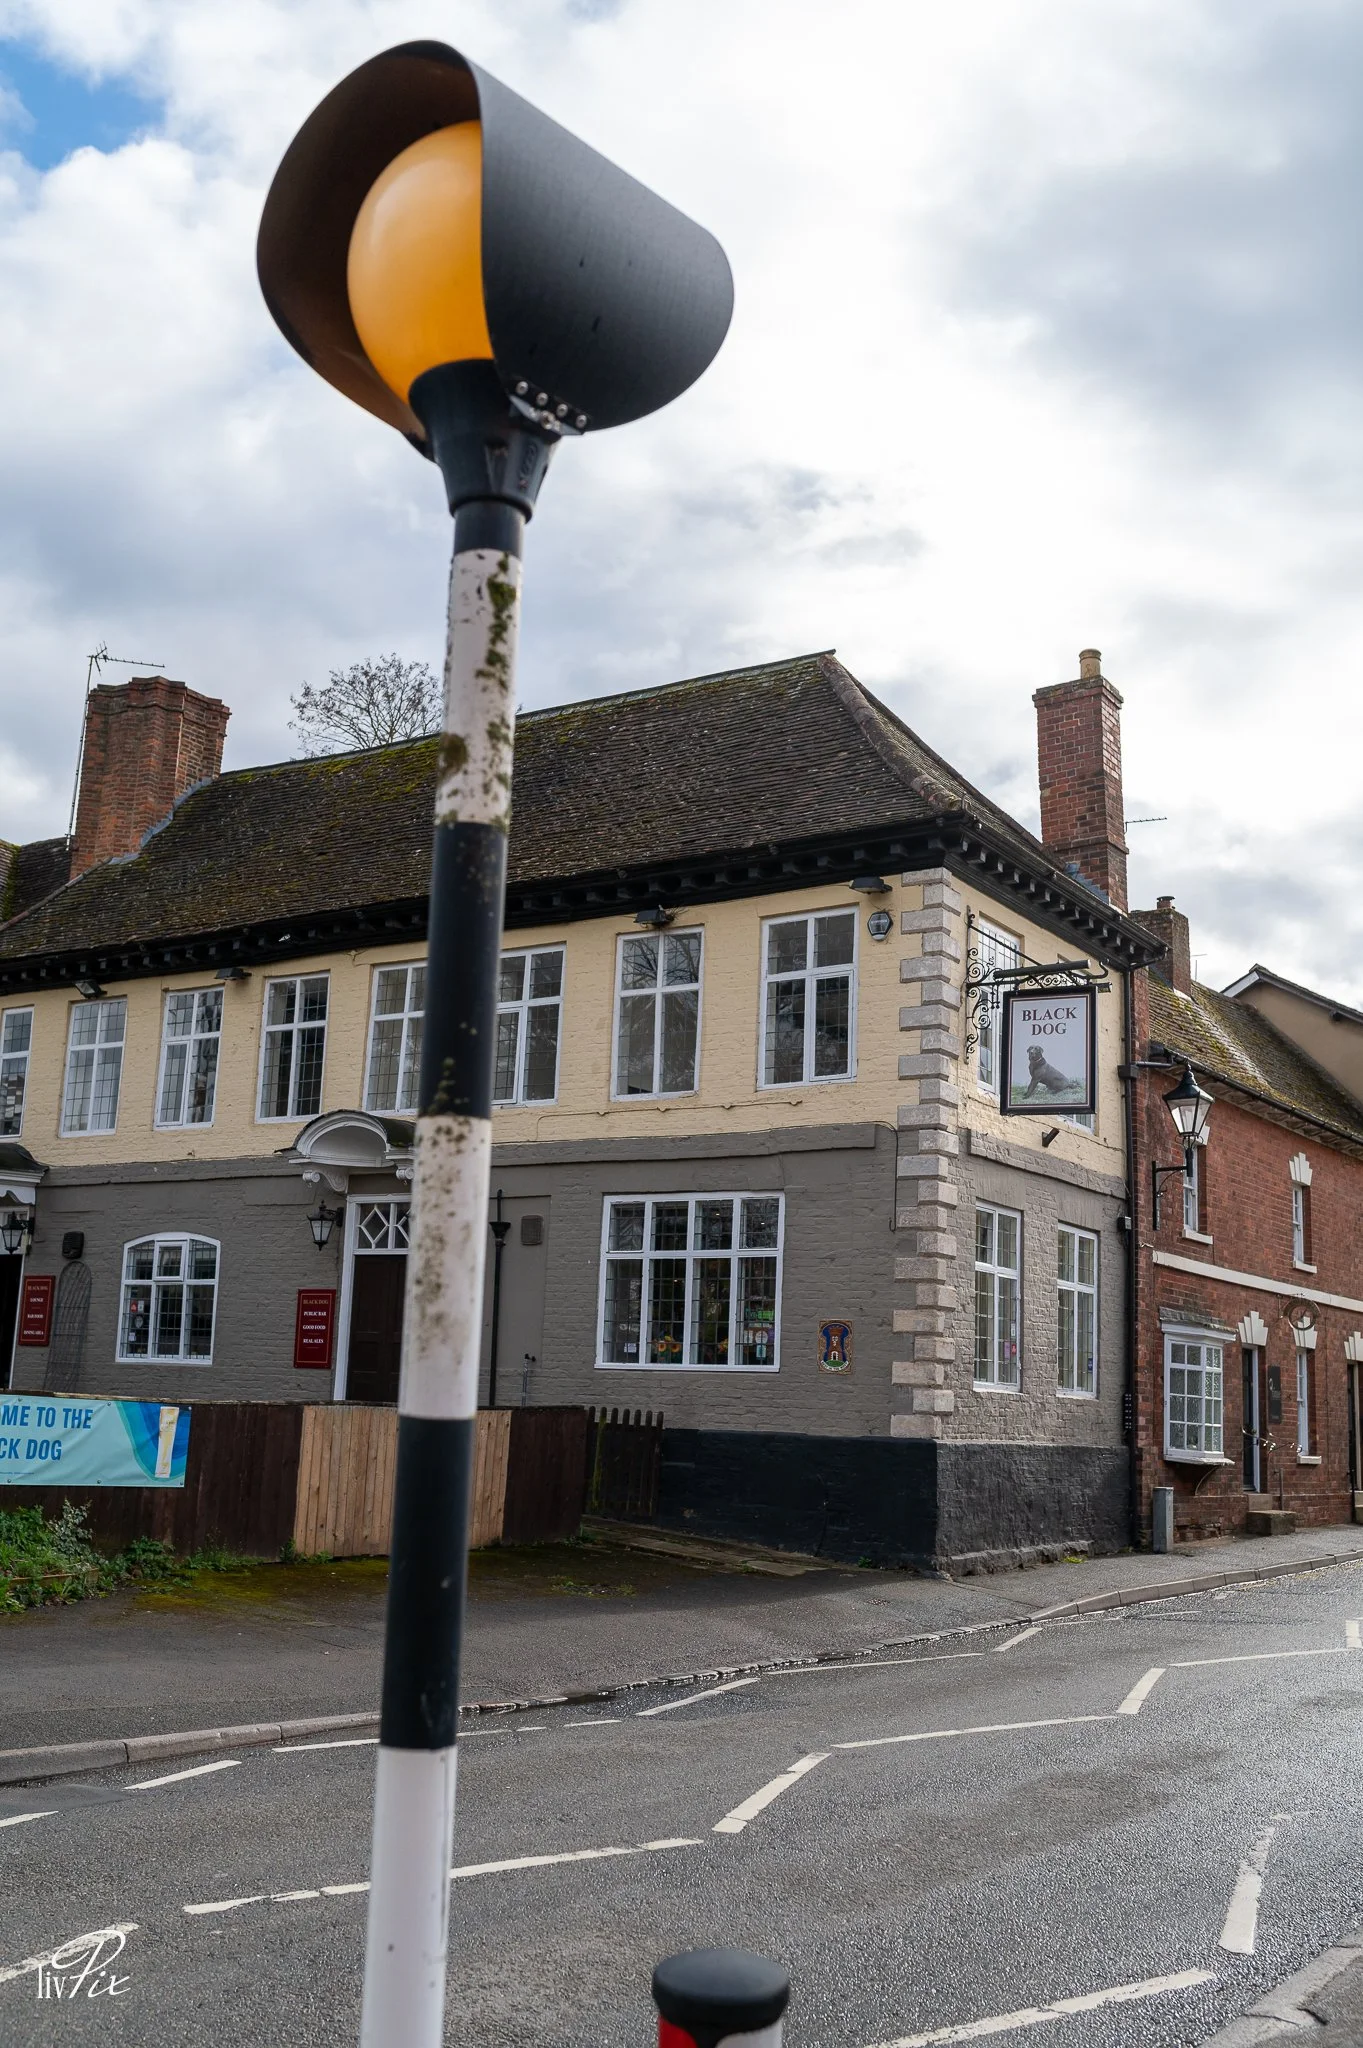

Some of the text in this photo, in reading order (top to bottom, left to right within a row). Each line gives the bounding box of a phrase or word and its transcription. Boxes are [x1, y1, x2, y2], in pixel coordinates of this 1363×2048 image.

[1022, 1007, 1077, 1021] BLACK
[1032, 1023, 1066, 1036] DOG
[0, 1405, 94, 1429] ME TO THE
[26, 1439, 62, 1460] DOG
